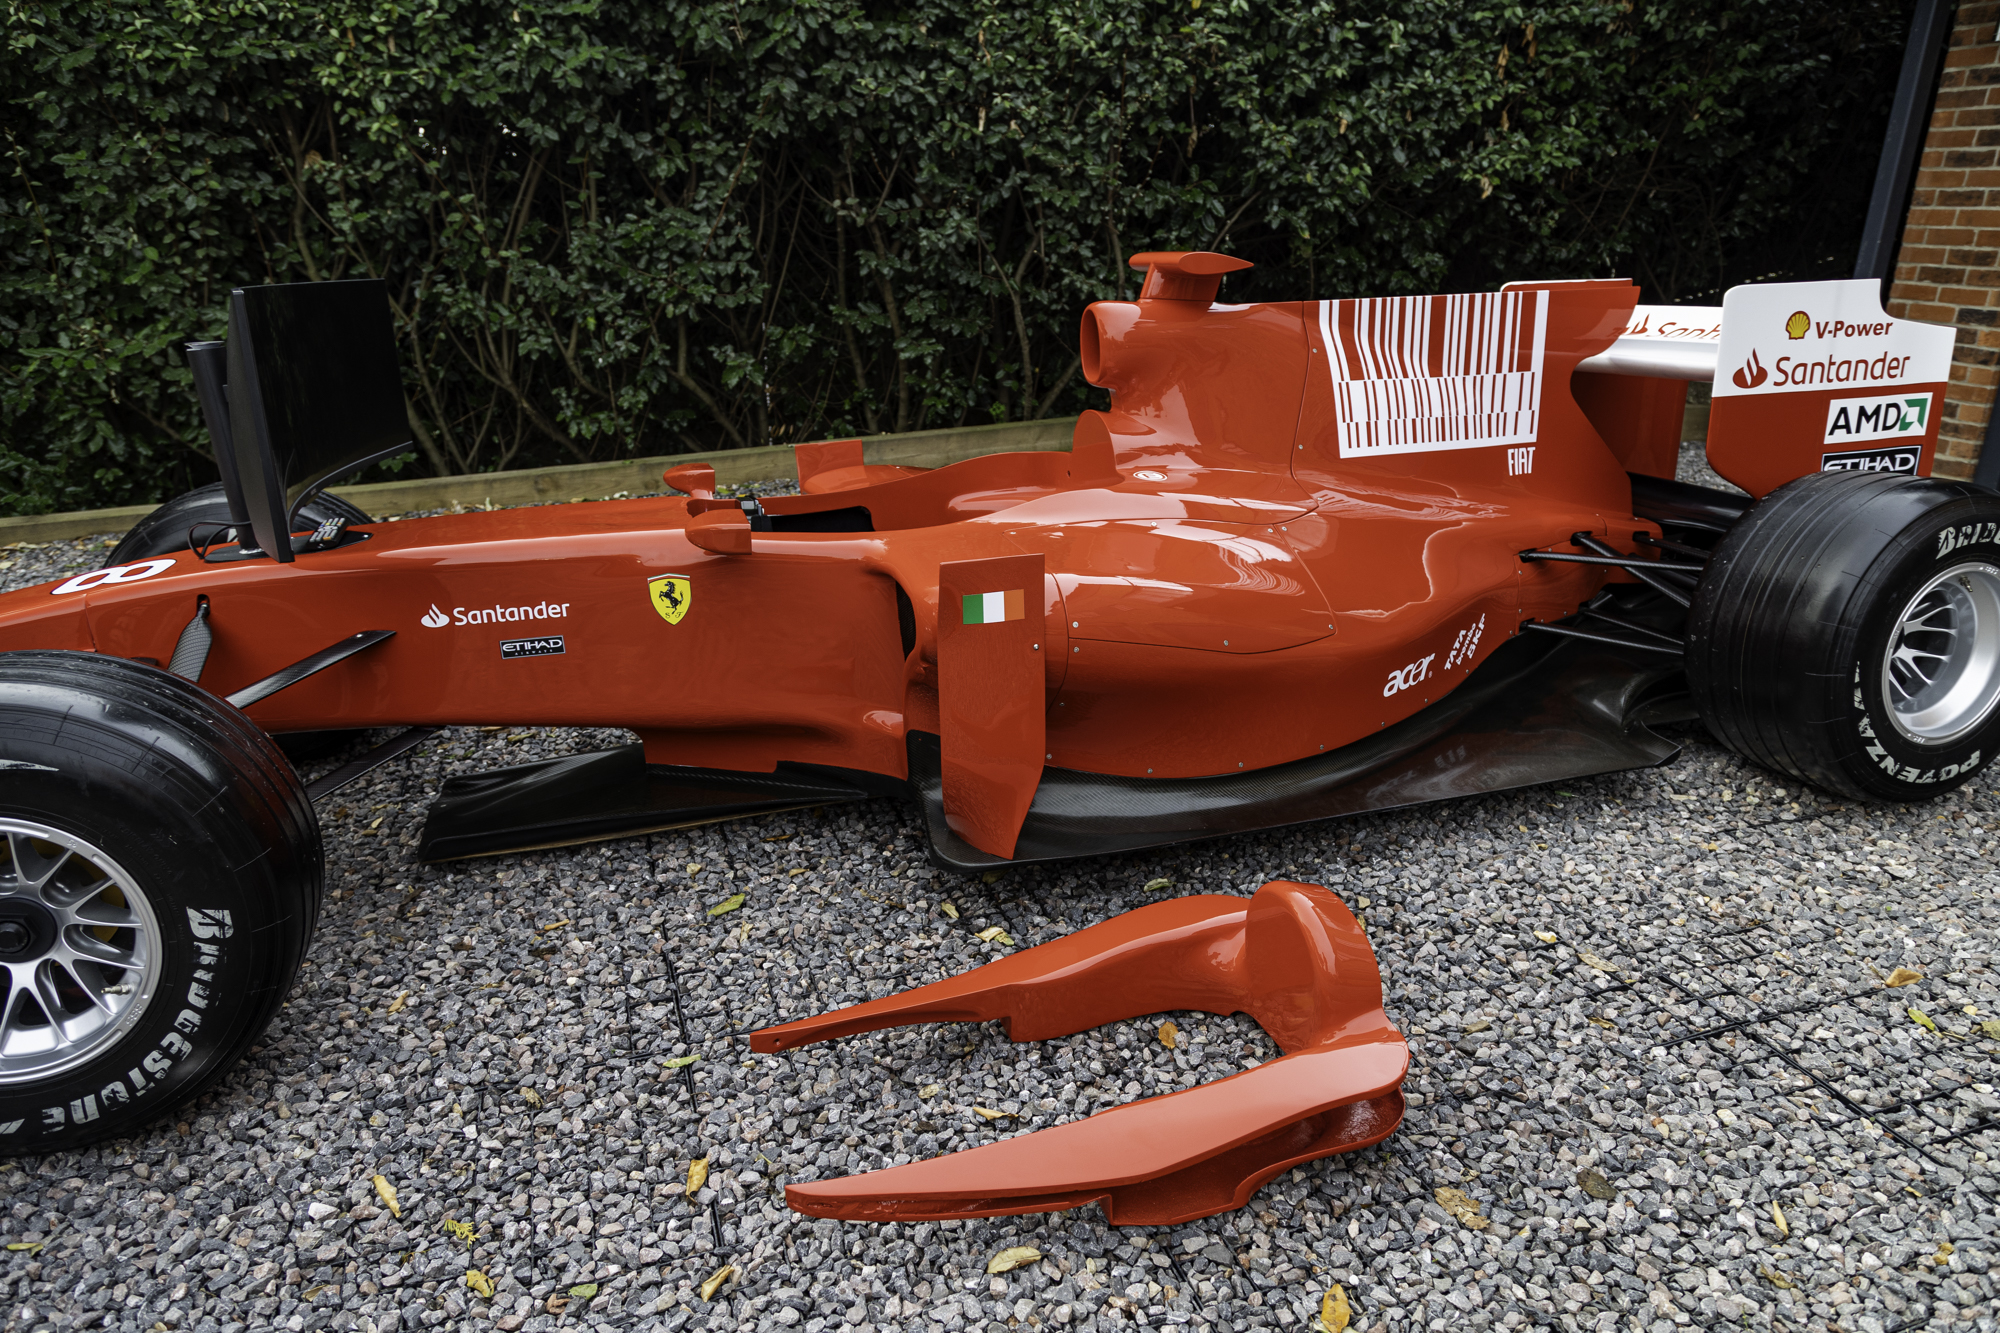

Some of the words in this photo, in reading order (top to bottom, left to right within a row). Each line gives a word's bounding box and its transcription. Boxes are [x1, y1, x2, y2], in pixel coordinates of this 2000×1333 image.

[1645, 321, 1721, 340] Sant
[1815, 320, 1893, 339] V-Power
[1773, 351, 1911, 387] Santander
[1827, 402, 1902, 436] AMD
[1507, 446, 1536, 476] FIAT
[1823, 453, 1915, 473] ETIHAD
[51, 559, 177, 595] 8
[453, 601, 570, 626] Santander
[502, 639, 562, 652] ETIHAD
[1444, 630, 1467, 670] TATA
[1456, 623, 1476, 665] brembo
[1467, 612, 1486, 659] SKF
[1383, 653, 1435, 697] acer
[1858, 713, 1981, 784] POTENZA
[42, 906, 234, 1134] BRIDGESTONE
